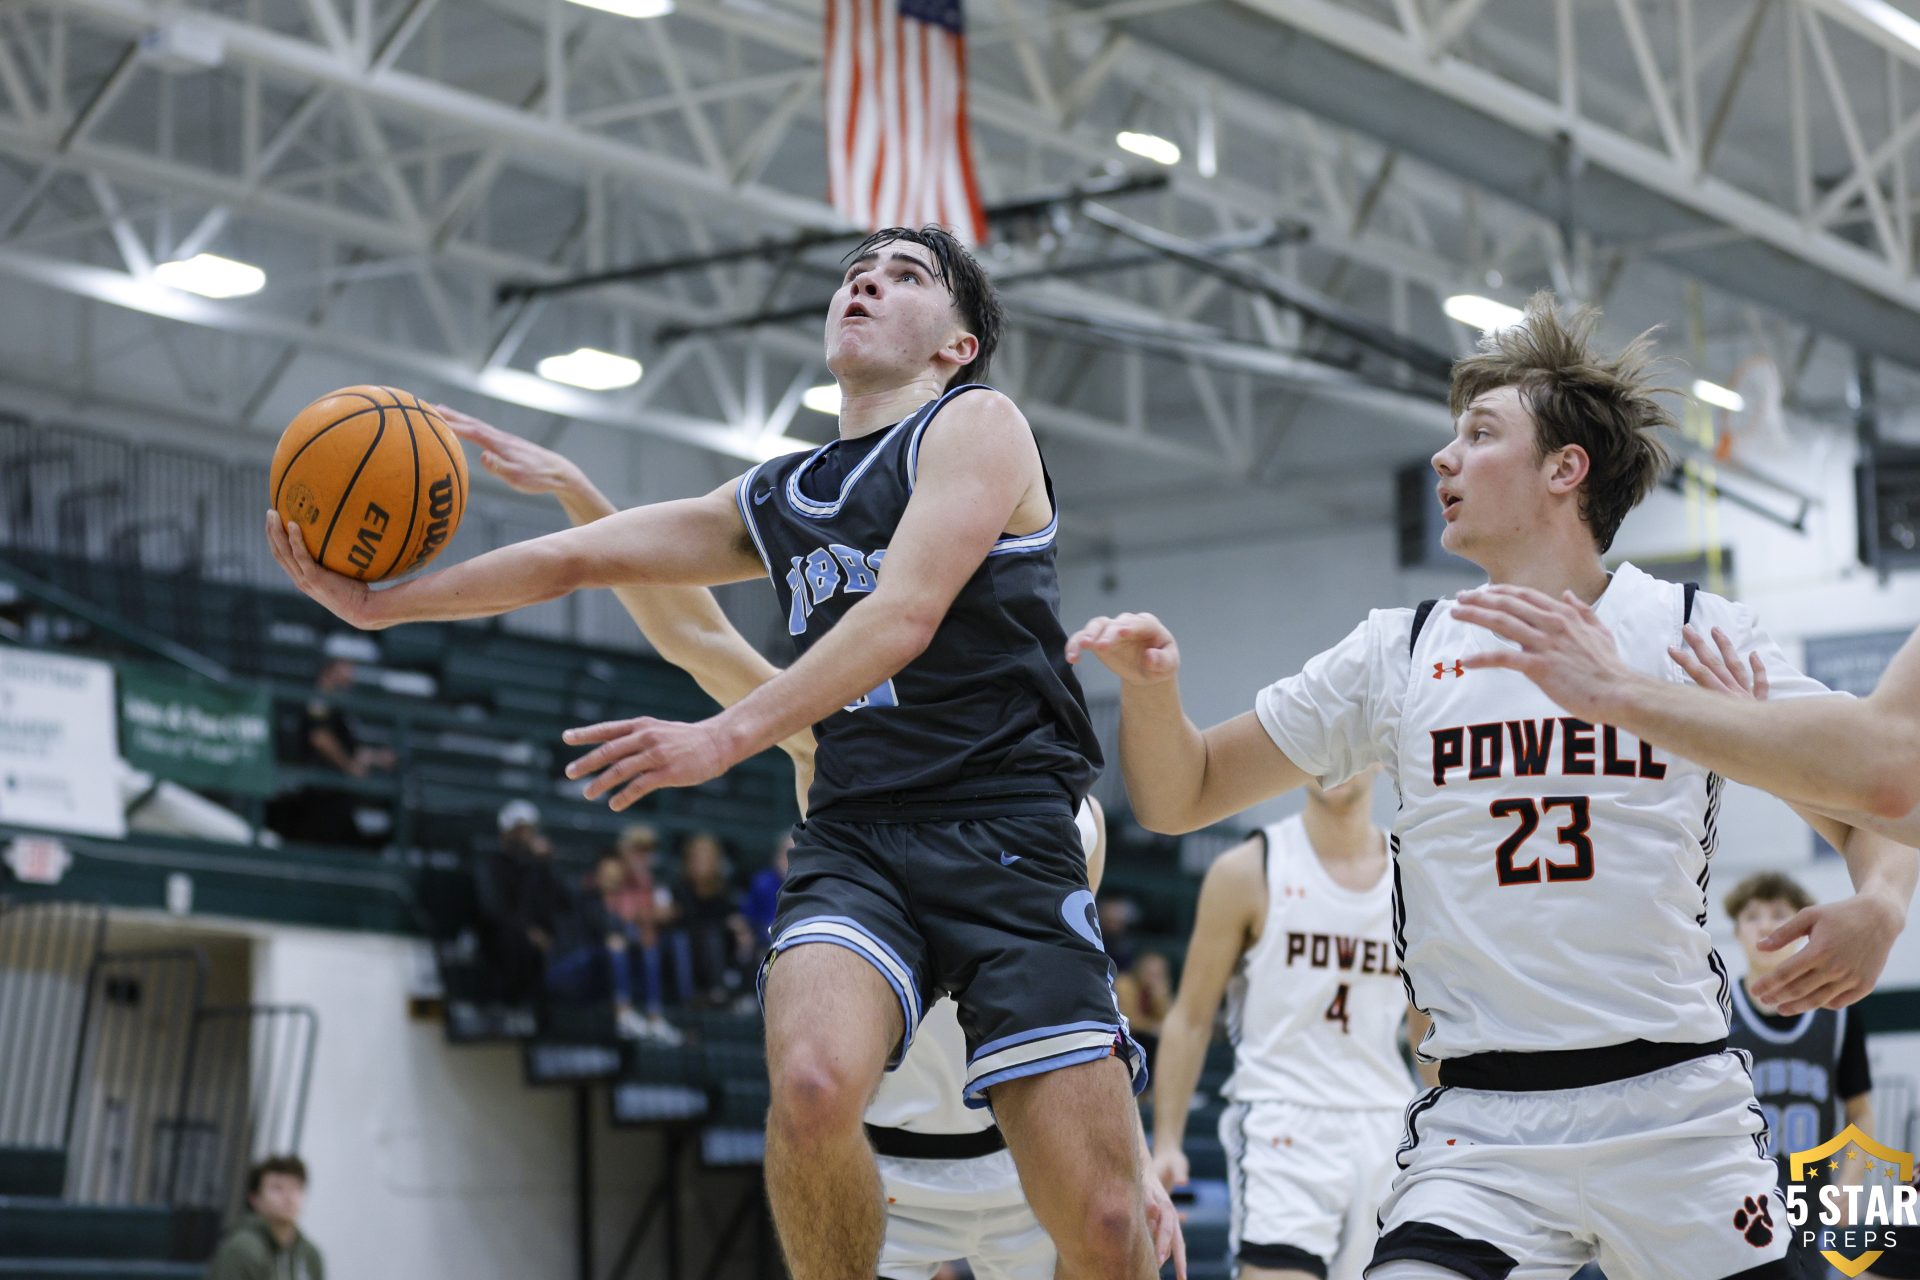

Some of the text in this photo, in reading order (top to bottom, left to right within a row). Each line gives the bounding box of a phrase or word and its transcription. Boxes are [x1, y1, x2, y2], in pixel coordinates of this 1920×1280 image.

[1430, 717, 1667, 786] POWELL
[1489, 795, 1595, 887] 23
[1325, 983, 1349, 1034] 4
